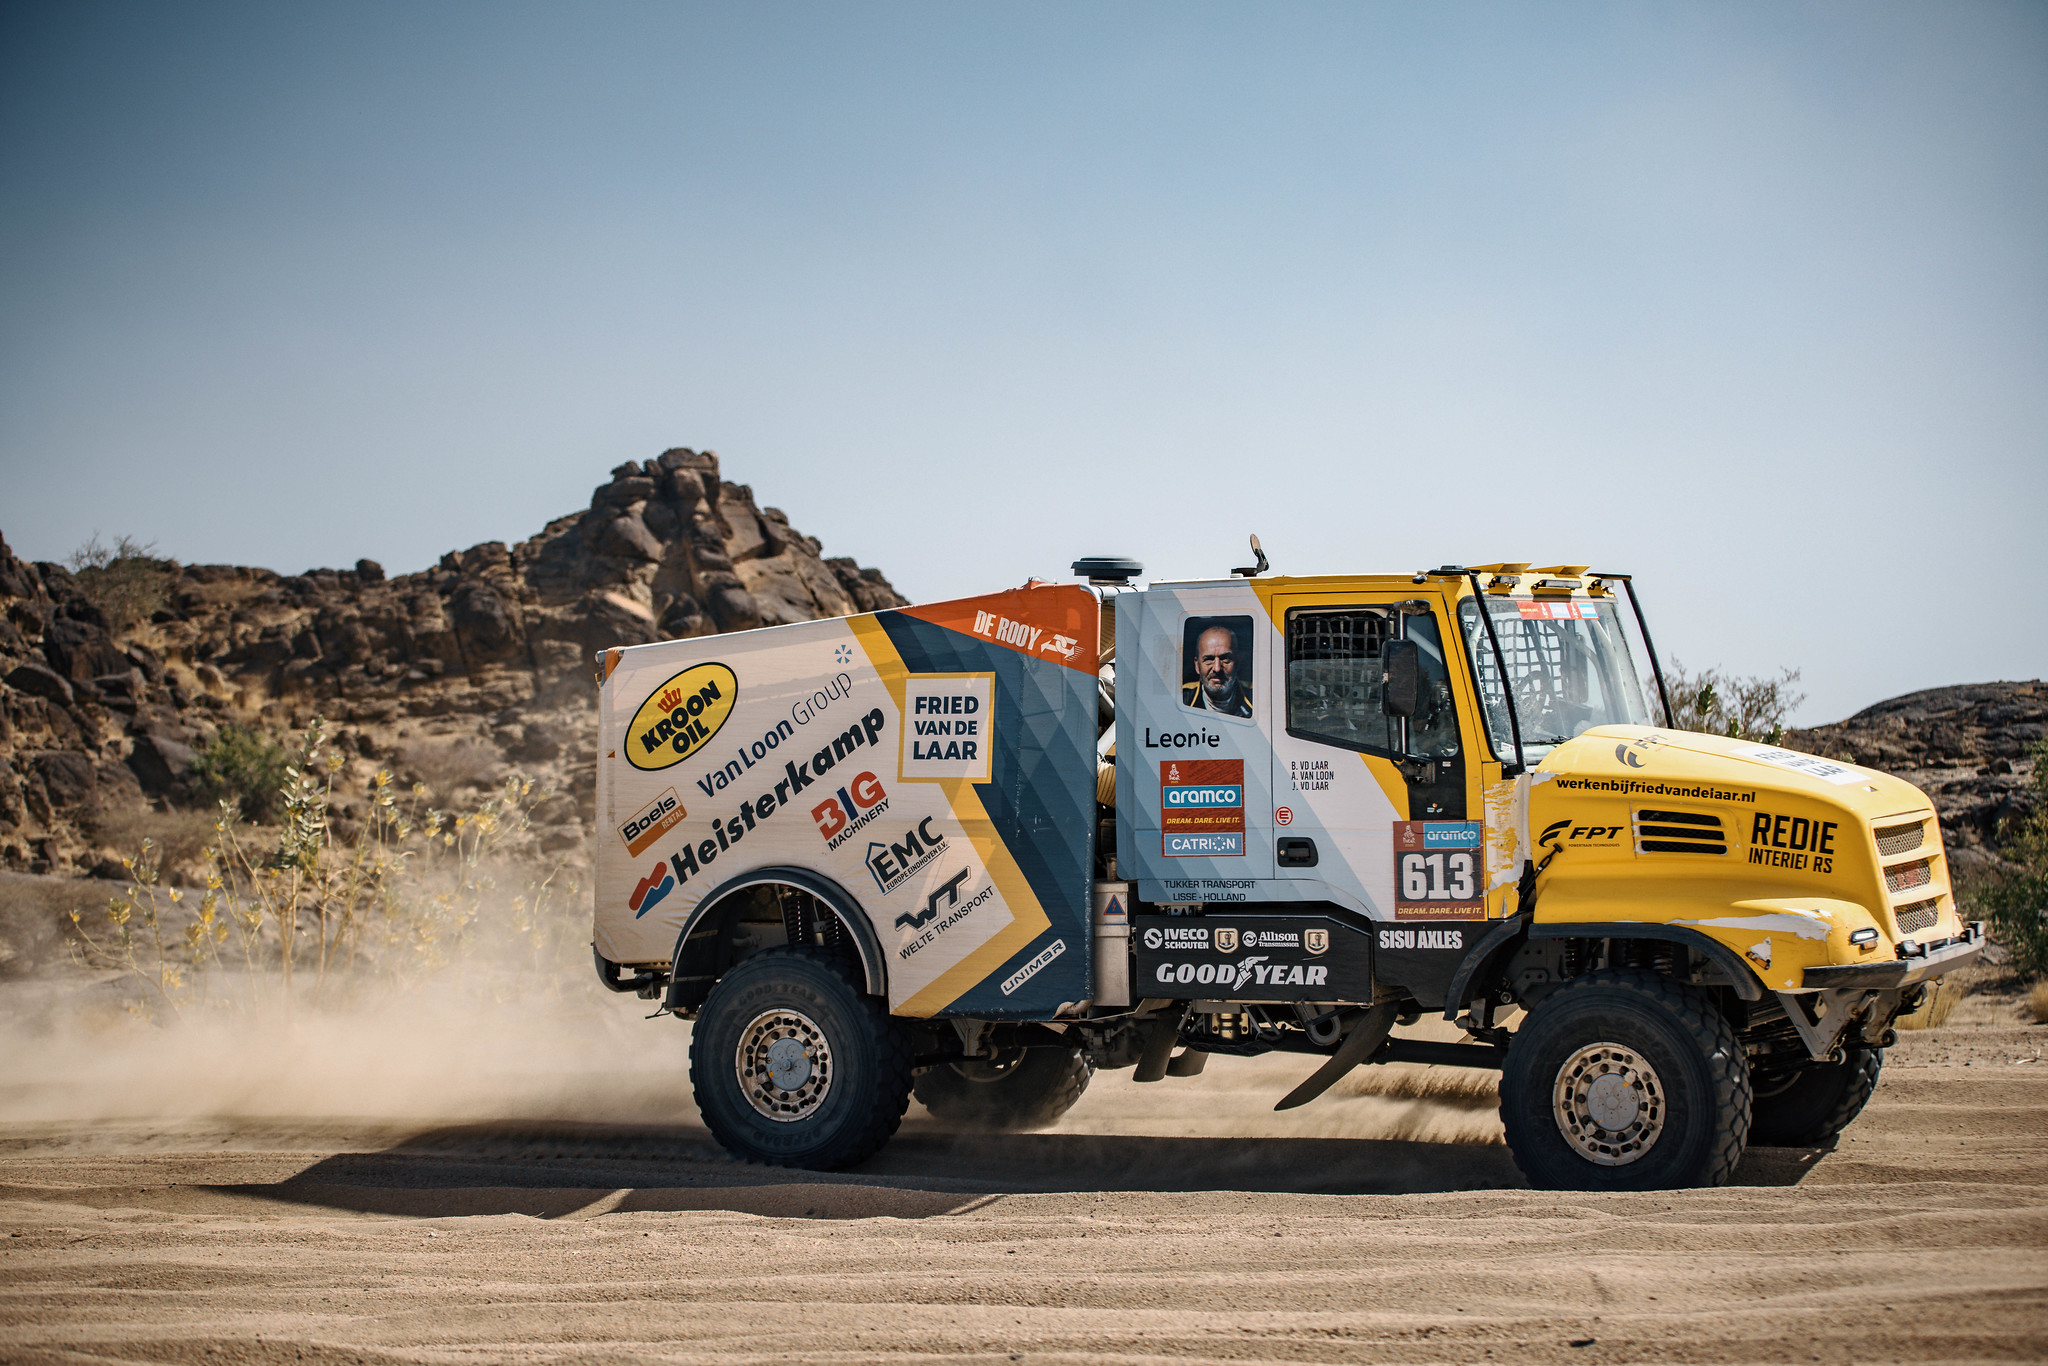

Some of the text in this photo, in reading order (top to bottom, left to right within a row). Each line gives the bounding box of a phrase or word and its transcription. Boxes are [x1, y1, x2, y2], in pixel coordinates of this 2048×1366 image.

[972, 609, 1043, 651] DE ROOY
[914, 695, 979, 715] FRIED
[640, 679, 722, 755] KROON
[672, 718, 711, 754] OIL
[696, 672, 852, 798] Van Loon Group
[914, 720, 978, 736] VAN DE
[1145, 727, 1220, 748] Leonie
[912, 740, 978, 760] LAAR
[1291, 760, 1299, 771] B.
[1311, 760, 1329, 771] LAAR
[1300, 771, 1314, 781] VAN
[1316, 770, 1335, 781] LOON
[1311, 781, 1329, 791] LAAR
[670, 707, 885, 886] Heisterkamp
[810, 771, 887, 841] BIG
[1168, 789, 1237, 804] aramco
[622, 796, 677, 841] Boels
[661, 809, 684, 830] RENTAL
[828, 798, 890, 851] MACHINERY
[1166, 817, 1194, 825] DREAM.
[1194, 817, 1215, 825] DARE.
[1215, 816, 1231, 824] LIVE
[1427, 830, 1477, 841] aramco
[1568, 826, 1625, 840] FPT
[1750, 811, 1838, 855] REDIE
[871, 815, 944, 884] EMC
[1171, 837, 1236, 851] CATRION
[886, 870, 909, 891] EUROPE
[907, 847, 939, 875] EINDHOVEN
[1402, 853, 1475, 900] 613
[1164, 880, 1256, 889] TUKKER TRANSPORT
[1172, 892, 1197, 902] LISSE
[1203, 892, 1246, 902] HOLLAND
[1397, 907, 1428, 915] DREAM.
[1428, 907, 1453, 915] DARE.
[899, 886, 994, 960] WELTE TRANSPORT
[1164, 928, 1209, 941] IVECO
[1258, 931, 1299, 942] Allison
[1379, 929, 1463, 950] SISU AXLES
[1164, 941, 1210, 950] SCHOUTEN
[1003, 942, 1064, 992] UNIMAR
